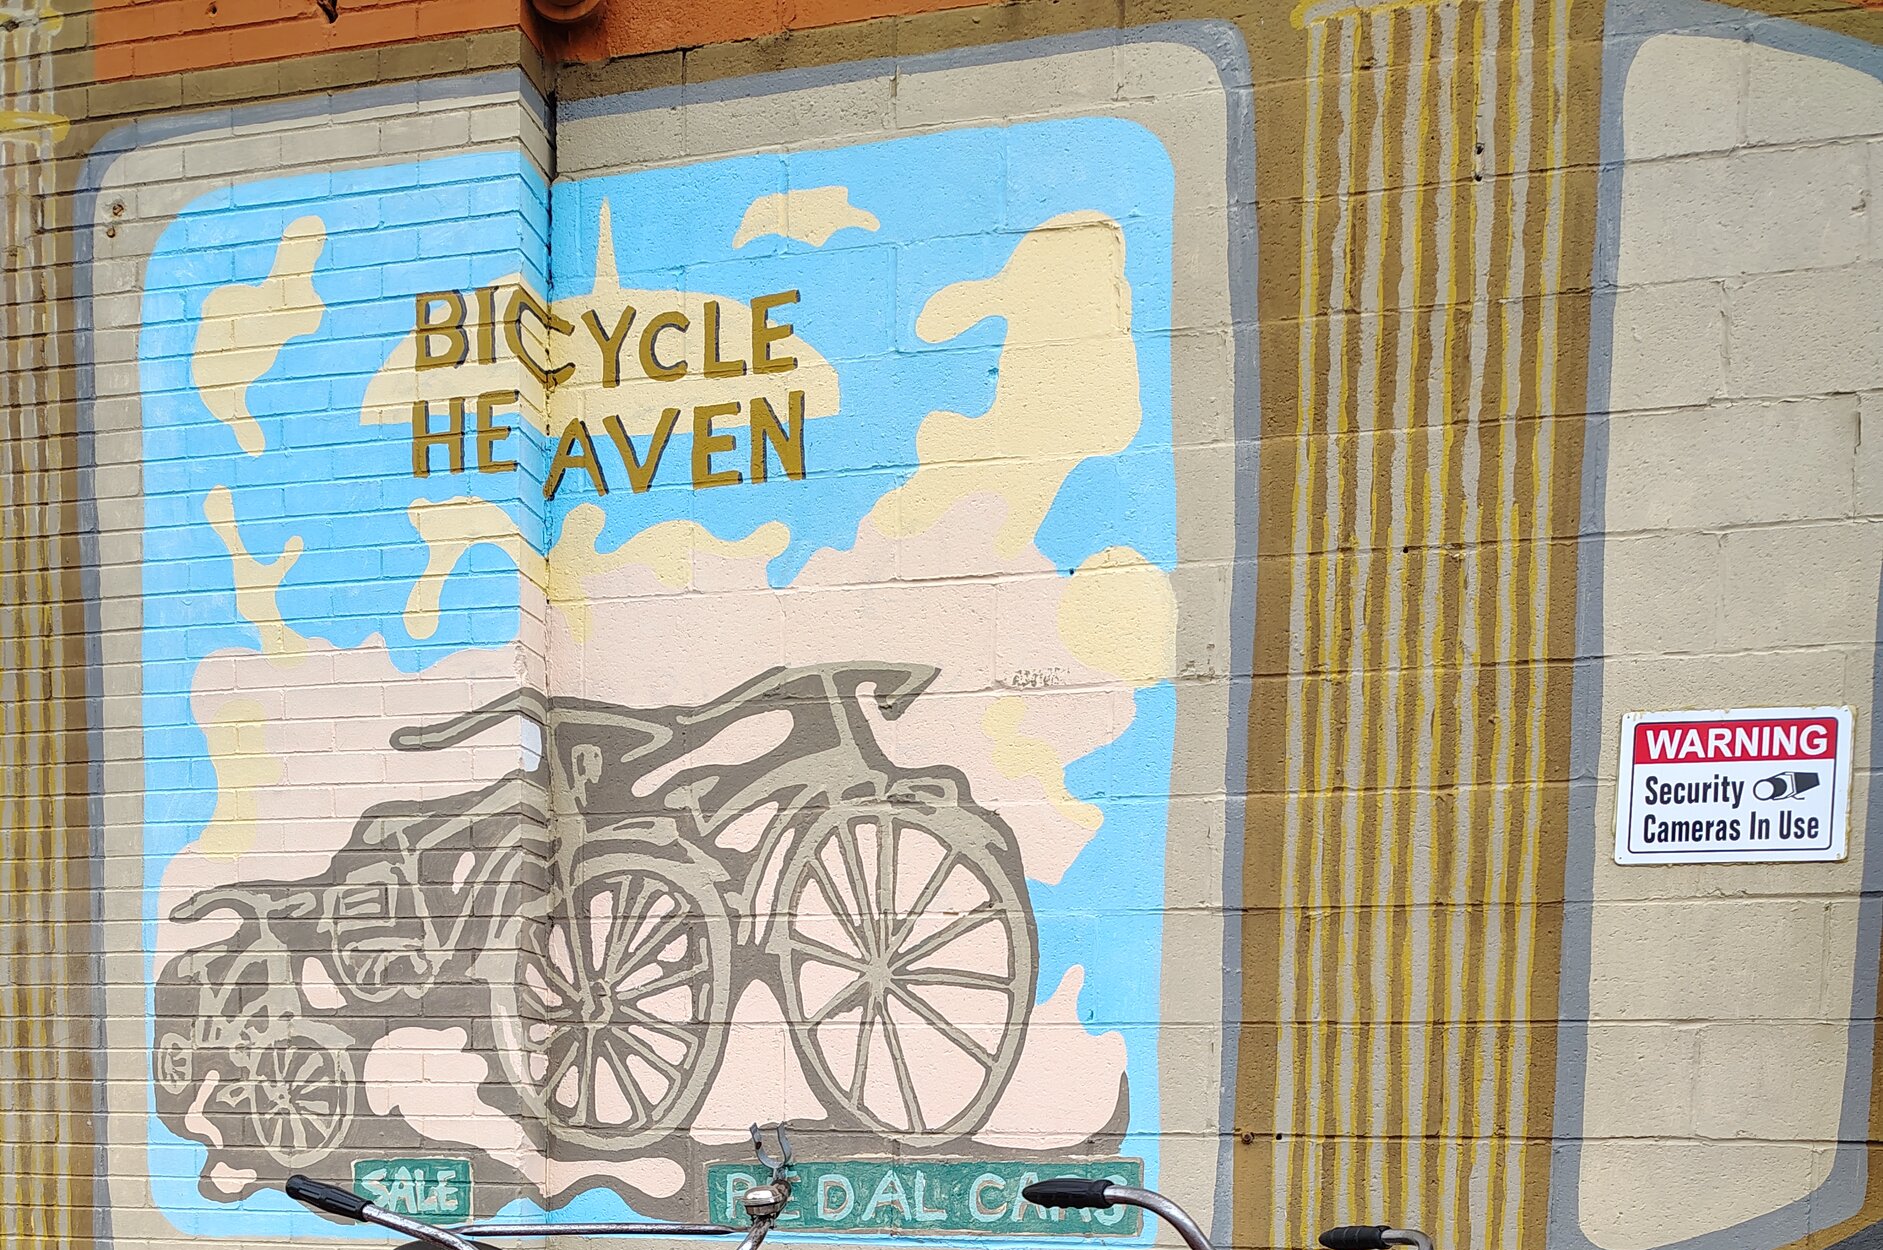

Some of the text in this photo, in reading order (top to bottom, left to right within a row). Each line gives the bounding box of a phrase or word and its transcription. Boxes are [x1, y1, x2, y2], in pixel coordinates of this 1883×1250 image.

[415, 286, 801, 389] BICYCLE
[411, 389, 805, 501] HEAVEN
[1646, 724, 1828, 760] WARNING
[1644, 773, 1745, 809] Security
[1643, 810, 1820, 843] Cameras In Use
[361, 1166, 459, 1214] SALE
